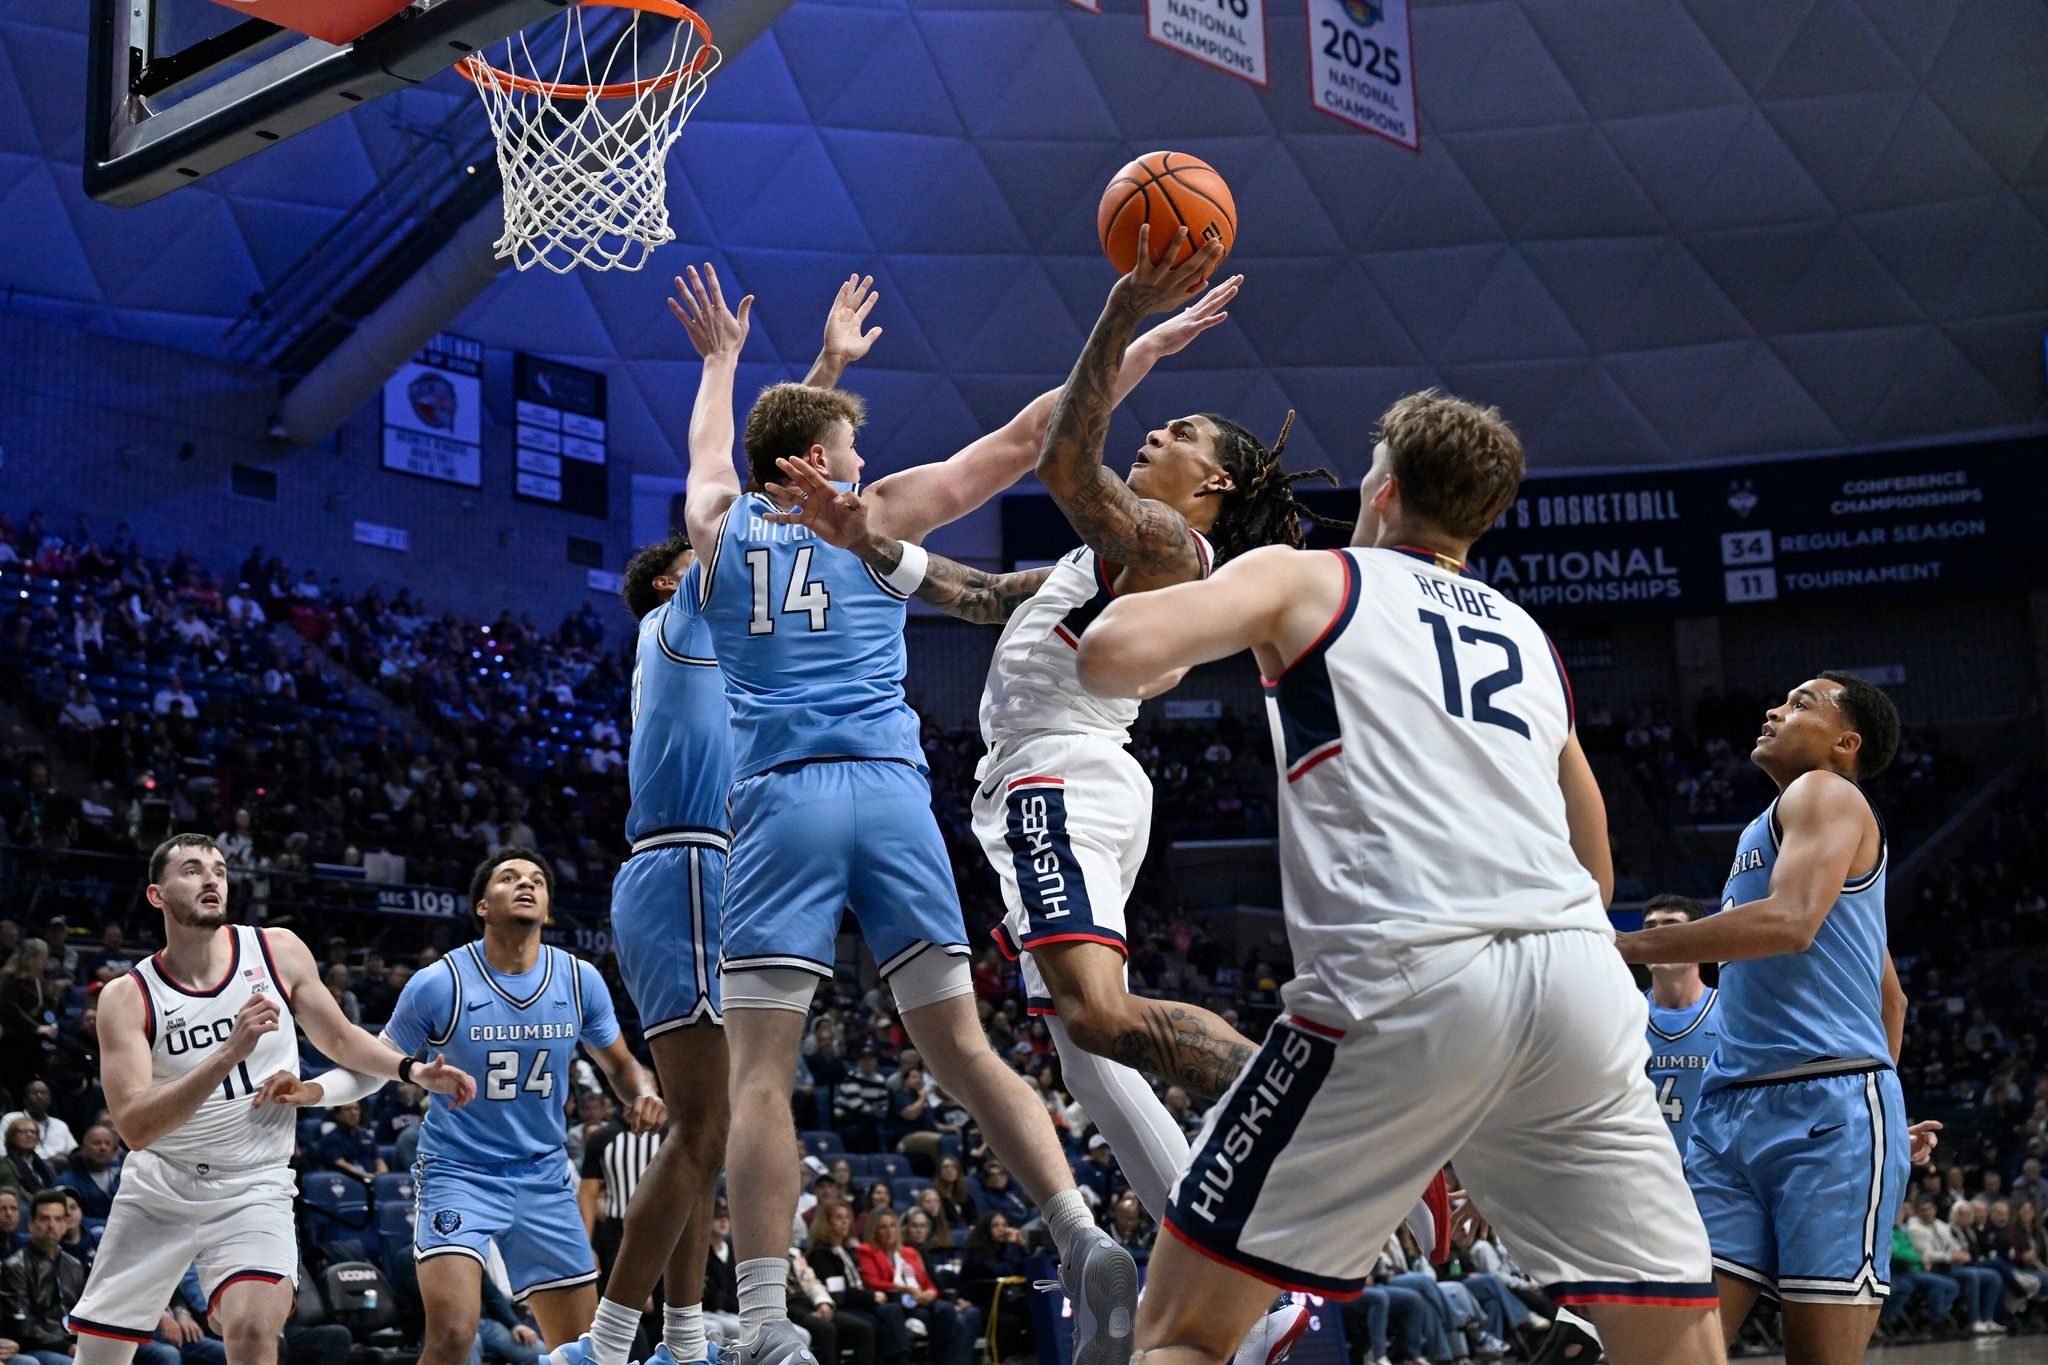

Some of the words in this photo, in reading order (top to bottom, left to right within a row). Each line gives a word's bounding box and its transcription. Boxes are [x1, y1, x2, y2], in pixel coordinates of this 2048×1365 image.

[1167, 0, 1246, 47] NATIONAL
[1162, 21, 1254, 72] CHAMPIONS
[1322, 20, 1401, 86] 2025
[1328, 67, 1398, 112] NATIONAL
[1324, 90, 1407, 137] CHAMPIONS
[1830, 488, 1983, 516] CHAMPIONSHIPS
[1842, 470, 1967, 496] CONFERENCE
[1538, 489, 1680, 527] BASKETBALL
[1730, 536, 1766, 560] 34
[1779, 527, 1886, 553] REGULAR
[1893, 519, 1986, 543] SEASON
[1467, 547, 1680, 585] NATIONAL
[1740, 575, 1763, 595] 11
[1784, 561, 1943, 591] TOURNAMENT
[745, 545, 831, 637] 14
[1412, 573, 1502, 621] REIBE
[1502, 579, 1681, 606] AMPIONSHIPS
[1418, 608, 1532, 741] 12
[411, 890, 456, 915] 109
[165, 1014, 239, 1056] UCO
[470, 1023, 575, 1041] COLUMBIA
[485, 1049, 553, 1101] 24
[1650, 1055, 1709, 1070] UMBI
[1190, 1031, 1312, 1224] HUSKIES
[337, 1269, 378, 1282] UCONN
